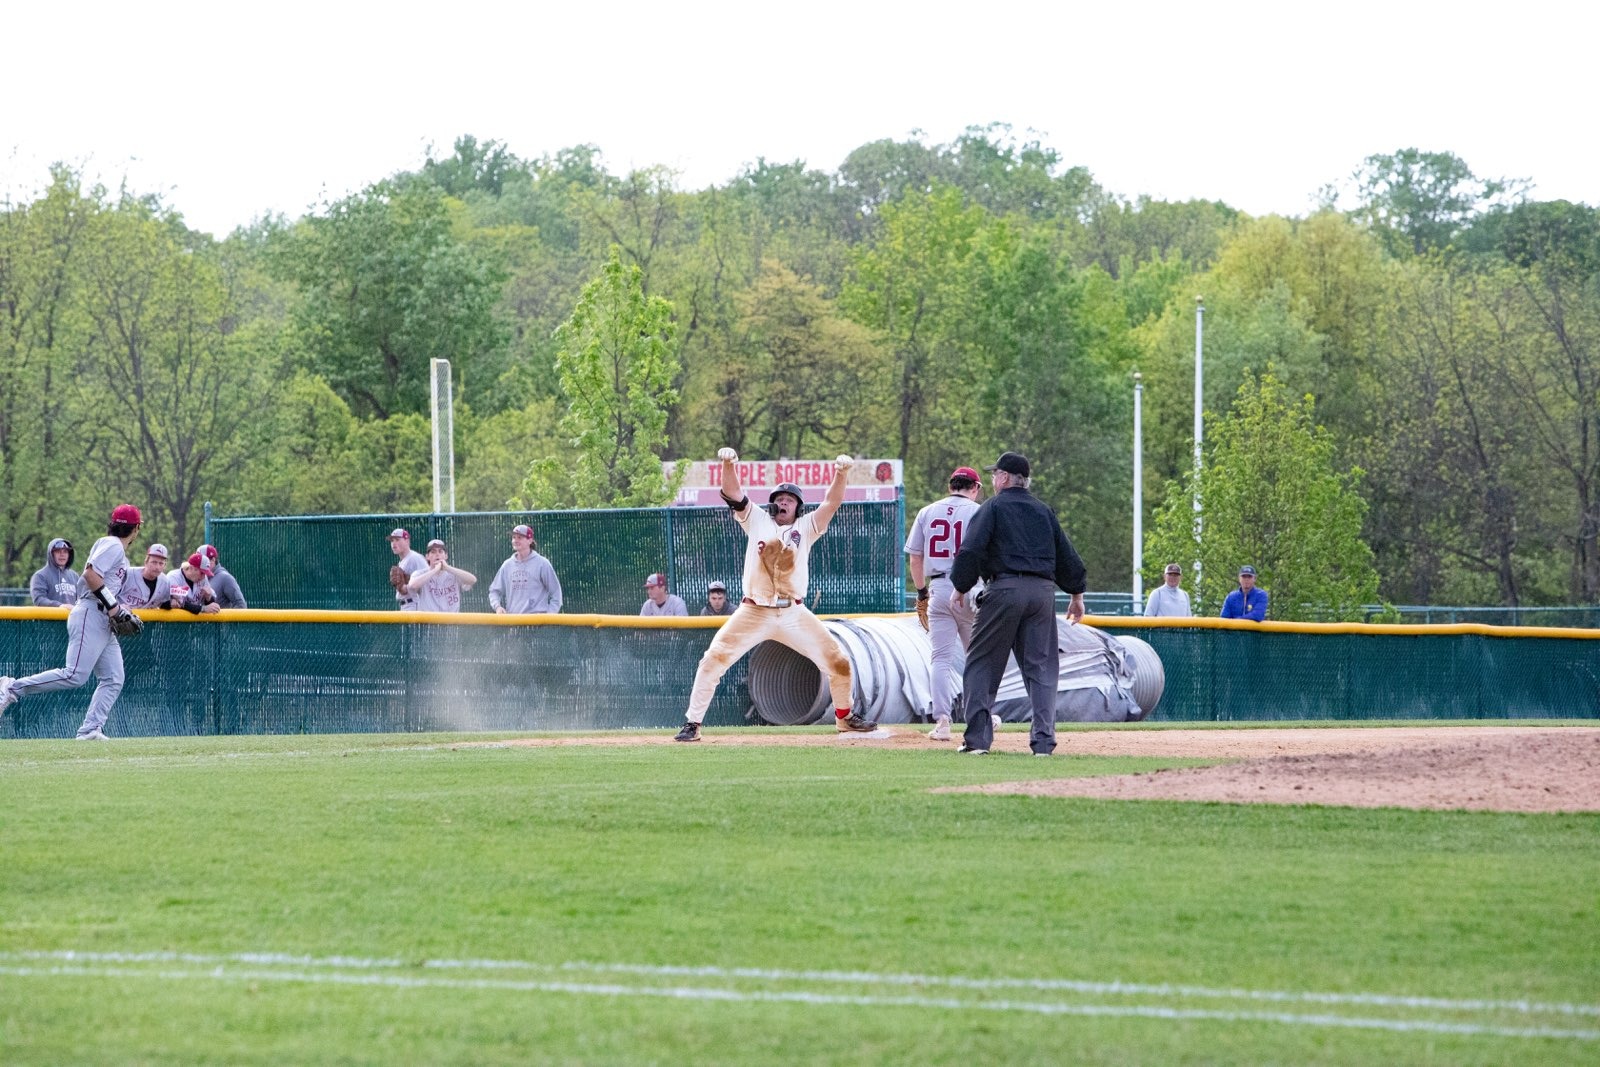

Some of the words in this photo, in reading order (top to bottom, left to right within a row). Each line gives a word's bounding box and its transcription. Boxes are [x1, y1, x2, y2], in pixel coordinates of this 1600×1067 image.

[708, 464, 766, 486] TEPLE
[946, 506, 954, 516] S
[928, 518, 963, 559] 21
